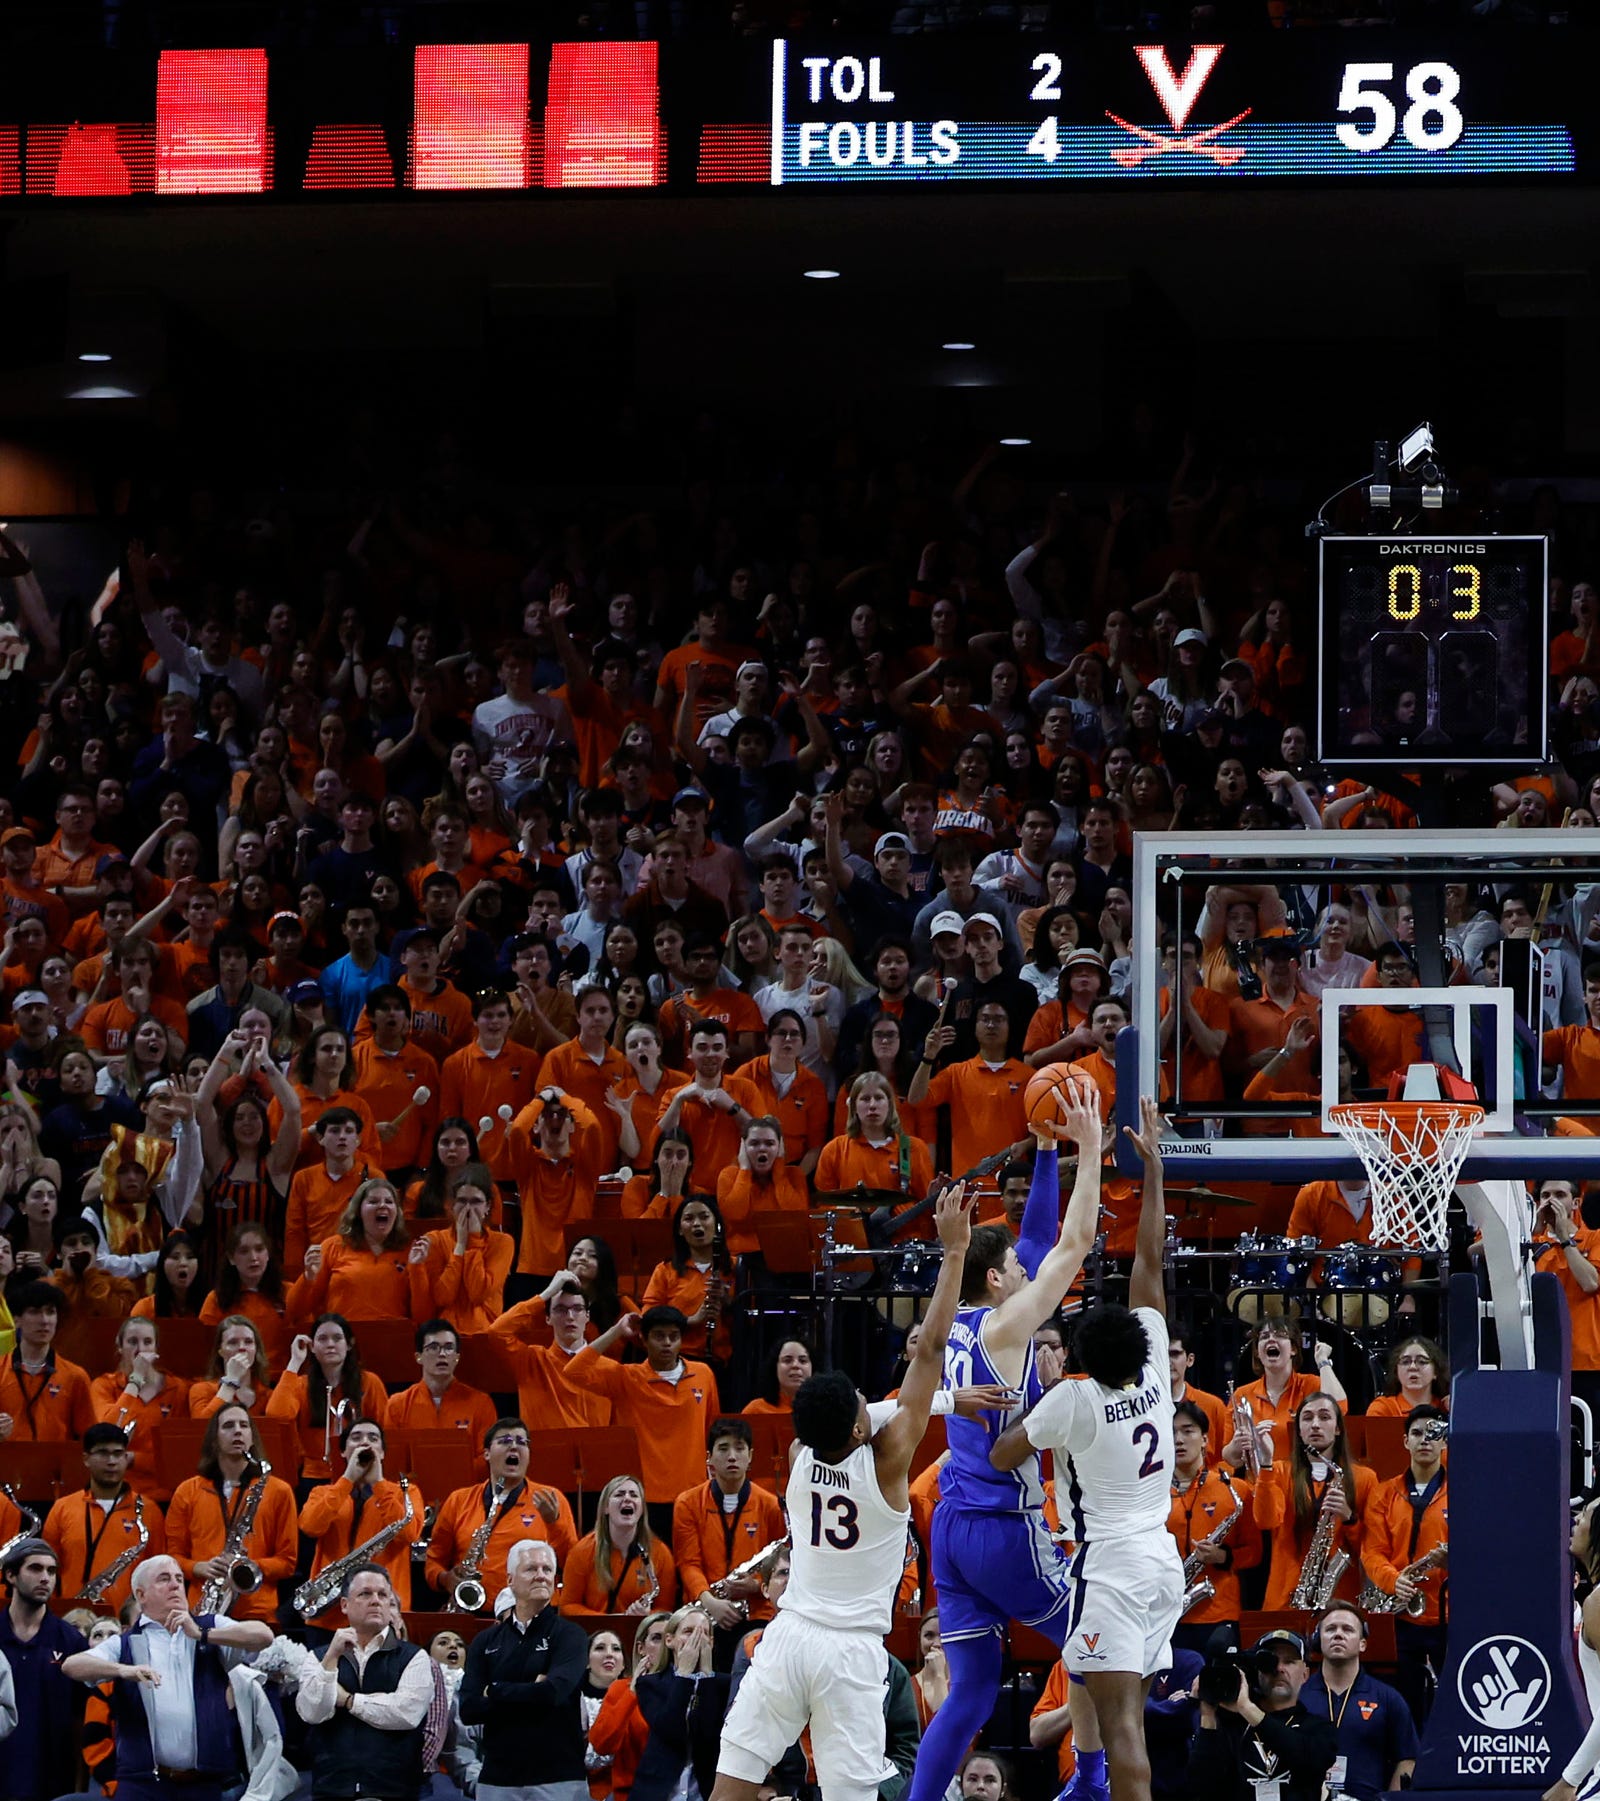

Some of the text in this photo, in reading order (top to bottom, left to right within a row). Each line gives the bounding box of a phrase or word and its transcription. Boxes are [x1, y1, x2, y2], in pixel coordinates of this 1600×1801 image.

[802, 53, 1062, 103] TOL 2
[1335, 61, 1464, 153] 58
[801, 116, 1063, 167] FOULS 4
[1379, 544, 1487, 555] DAKTRONICS
[1132, 1422, 1164, 1480] 2
[810, 1463, 850, 1491] DUNN
[810, 1490, 861, 1550] 13
[1457, 1735, 1552, 1753] VIRGINIA
[1457, 1756, 1552, 1774] LOTTERY
